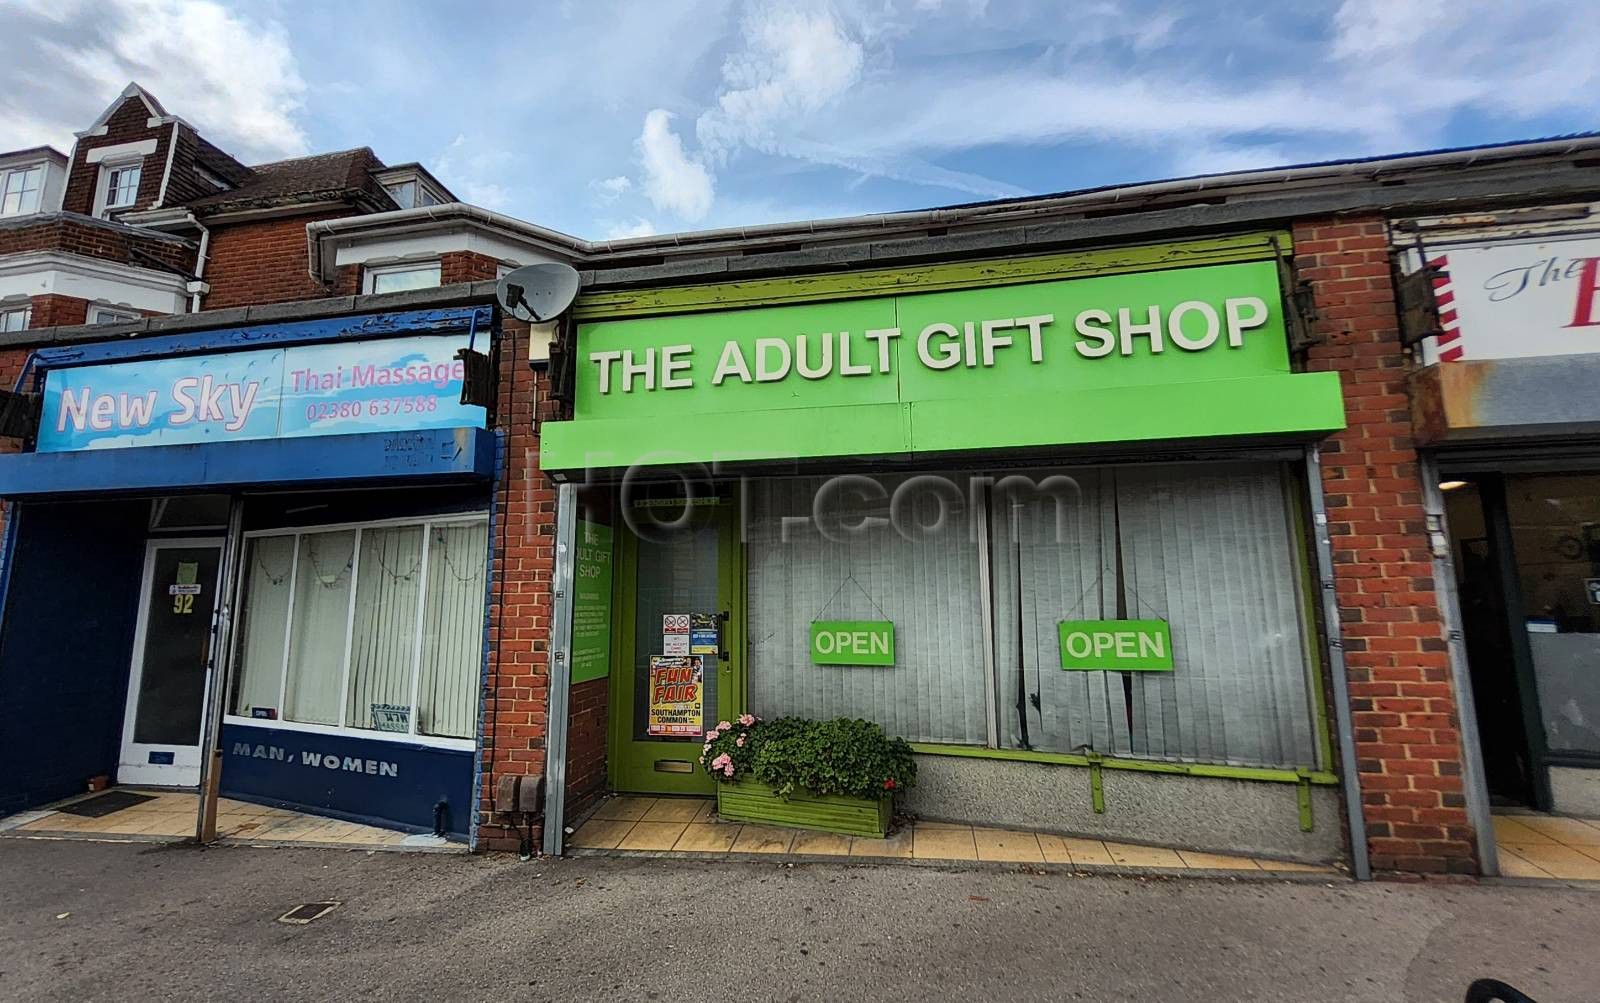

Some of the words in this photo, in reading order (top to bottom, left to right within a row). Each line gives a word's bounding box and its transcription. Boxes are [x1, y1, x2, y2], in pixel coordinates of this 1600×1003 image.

[1483, 255, 1585, 302] The
[590, 344, 694, 394] THE
[712, 327, 901, 386] ADULT
[916, 315, 1054, 370] GIFT
[1075, 296, 1269, 358] SHOP
[291, 365, 343, 392] Thai
[352, 361, 464, 388] Massage
[57, 386, 157, 433] New
[168, 374, 259, 432] Sky
[306, 402, 361, 421] 02380
[369, 395, 438, 416] 637588
[584, 531, 599, 545] THE
[595, 550, 611, 564] GIFT
[579, 564, 601, 579] SHOP
[173, 594, 193, 613] 92
[815, 631, 888, 654] OPEN
[1066, 632, 1164, 658] OPEN
[655, 667, 692, 685] FUN
[653, 684, 697, 704] FAIR
[233, 742, 293, 763] MAN,
[302, 752, 398, 777] WOMEN
